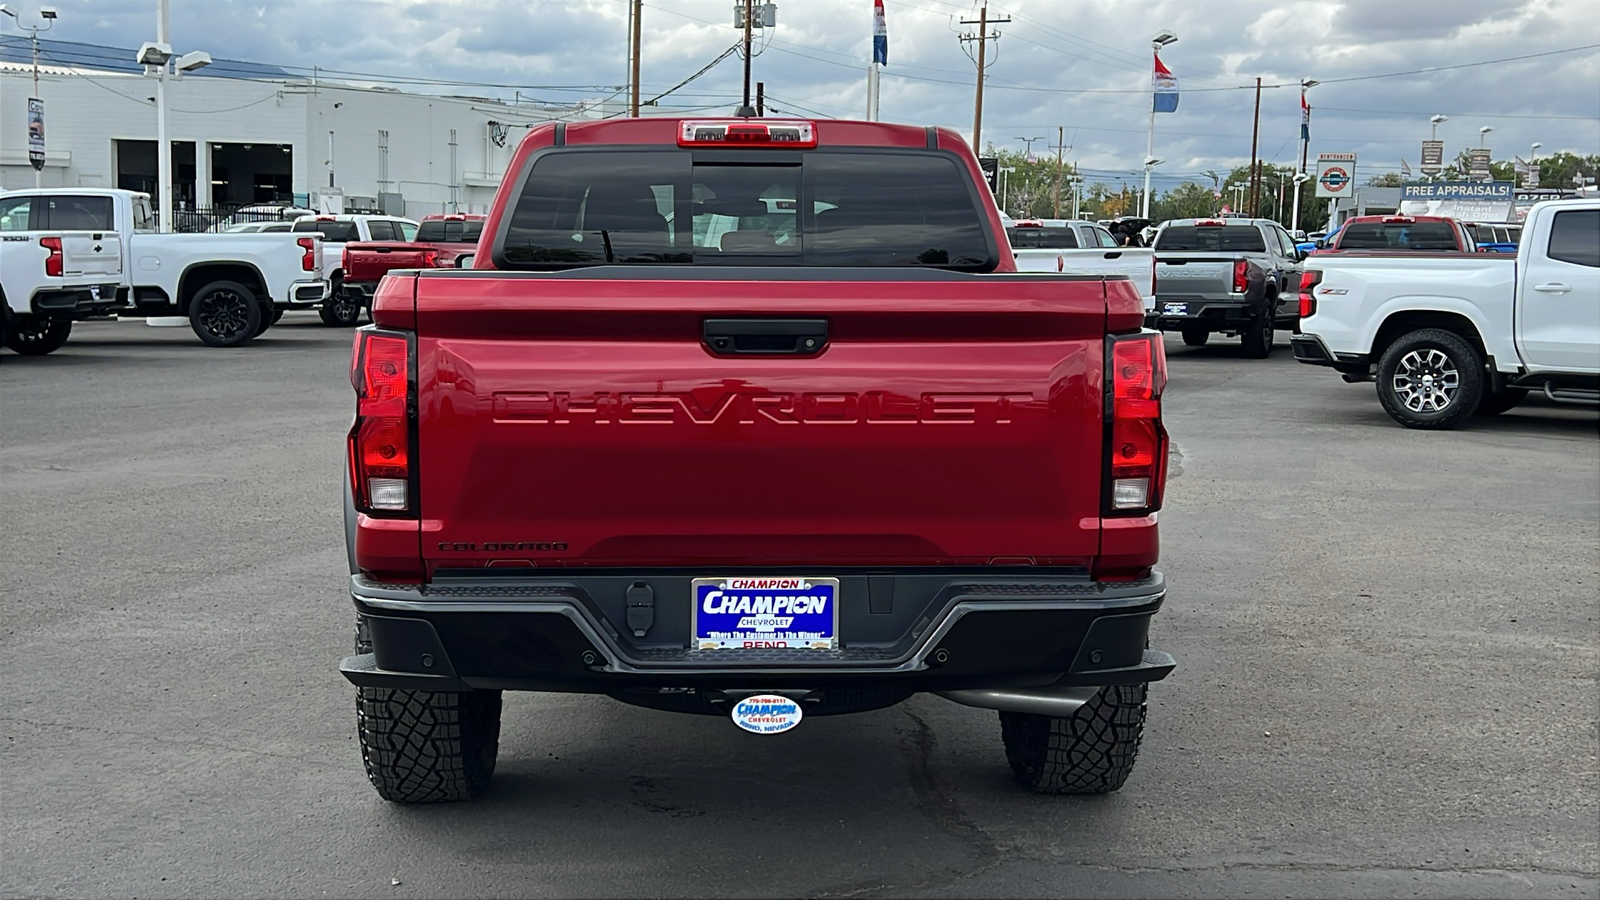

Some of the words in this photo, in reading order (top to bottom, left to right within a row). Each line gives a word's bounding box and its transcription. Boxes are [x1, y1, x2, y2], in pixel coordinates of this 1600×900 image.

[1406, 186, 1434, 196] FREE
[1436, 185, 1510, 196] APPRAISALS!
[1452, 204, 1493, 212] Instant
[1472, 211, 1500, 219] Offer
[492, 391, 1034, 424] CHEVROLET
[438, 542, 569, 551] COLORADO
[732, 580, 799, 589] CHAMPION
[702, 591, 827, 614] CHAMPION
[741, 618, 789, 626] CHEVROLET
[743, 641, 788, 649] RENO
[737, 703, 797, 715] CHAMPION
[764, 720, 795, 732] NEVADA
